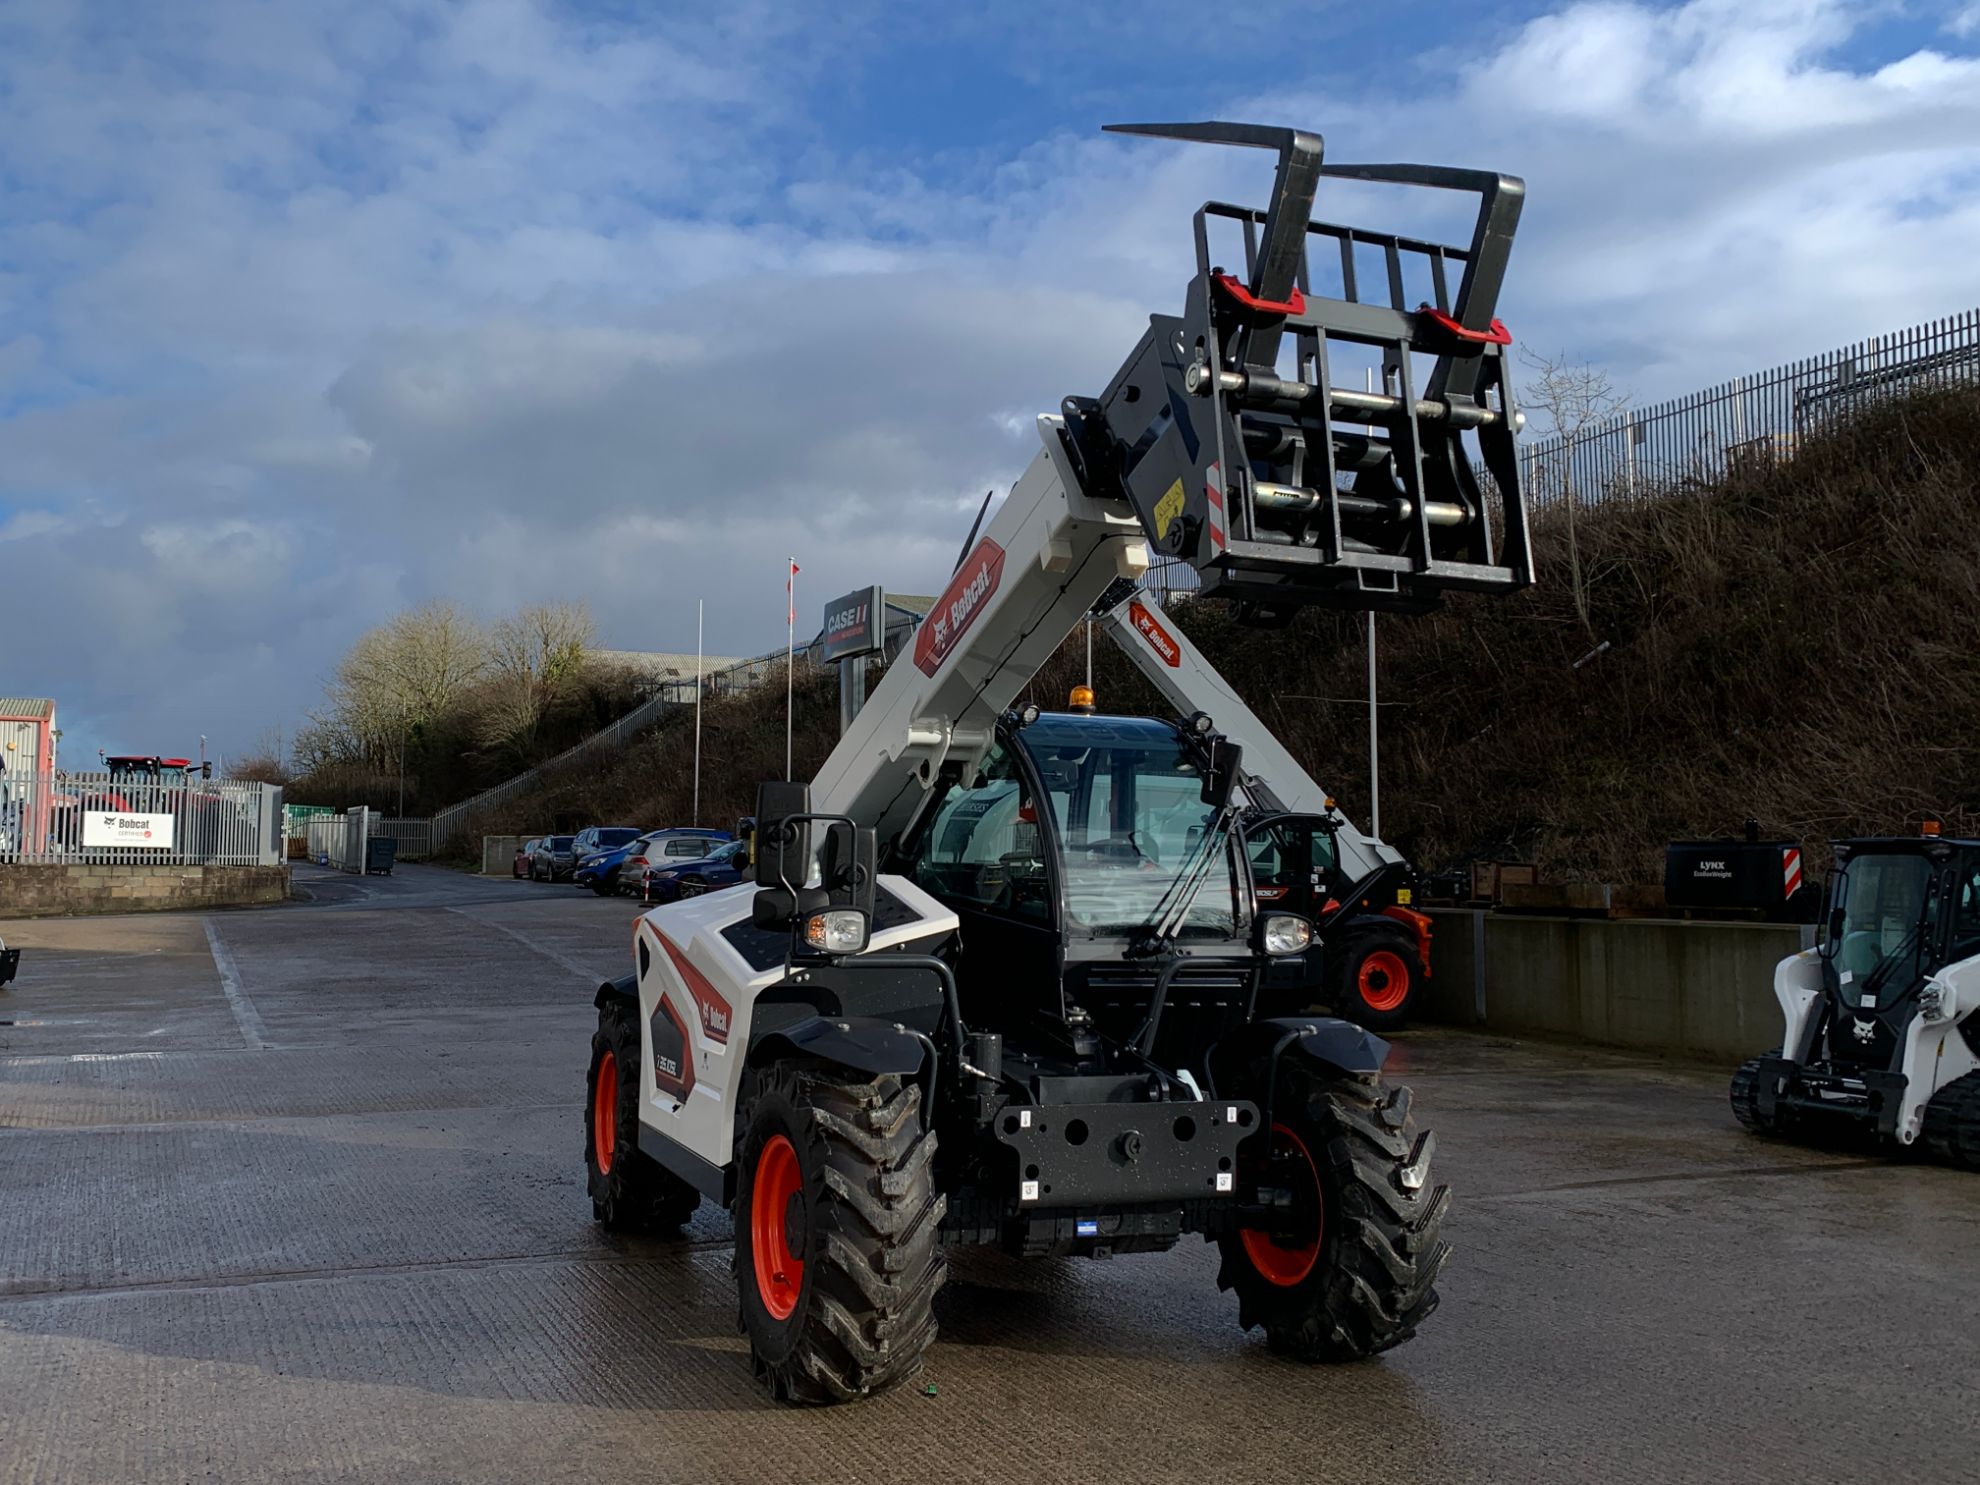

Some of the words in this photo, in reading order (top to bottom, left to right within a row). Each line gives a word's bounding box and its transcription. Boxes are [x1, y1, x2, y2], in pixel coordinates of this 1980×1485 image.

[950, 560, 991, 631] Bobcat
[828, 607, 855, 633] CASE
[1148, 629, 1174, 659] Bobcat
[118, 818, 149, 829] Bobcat
[1699, 860, 1725, 871] LYNX
